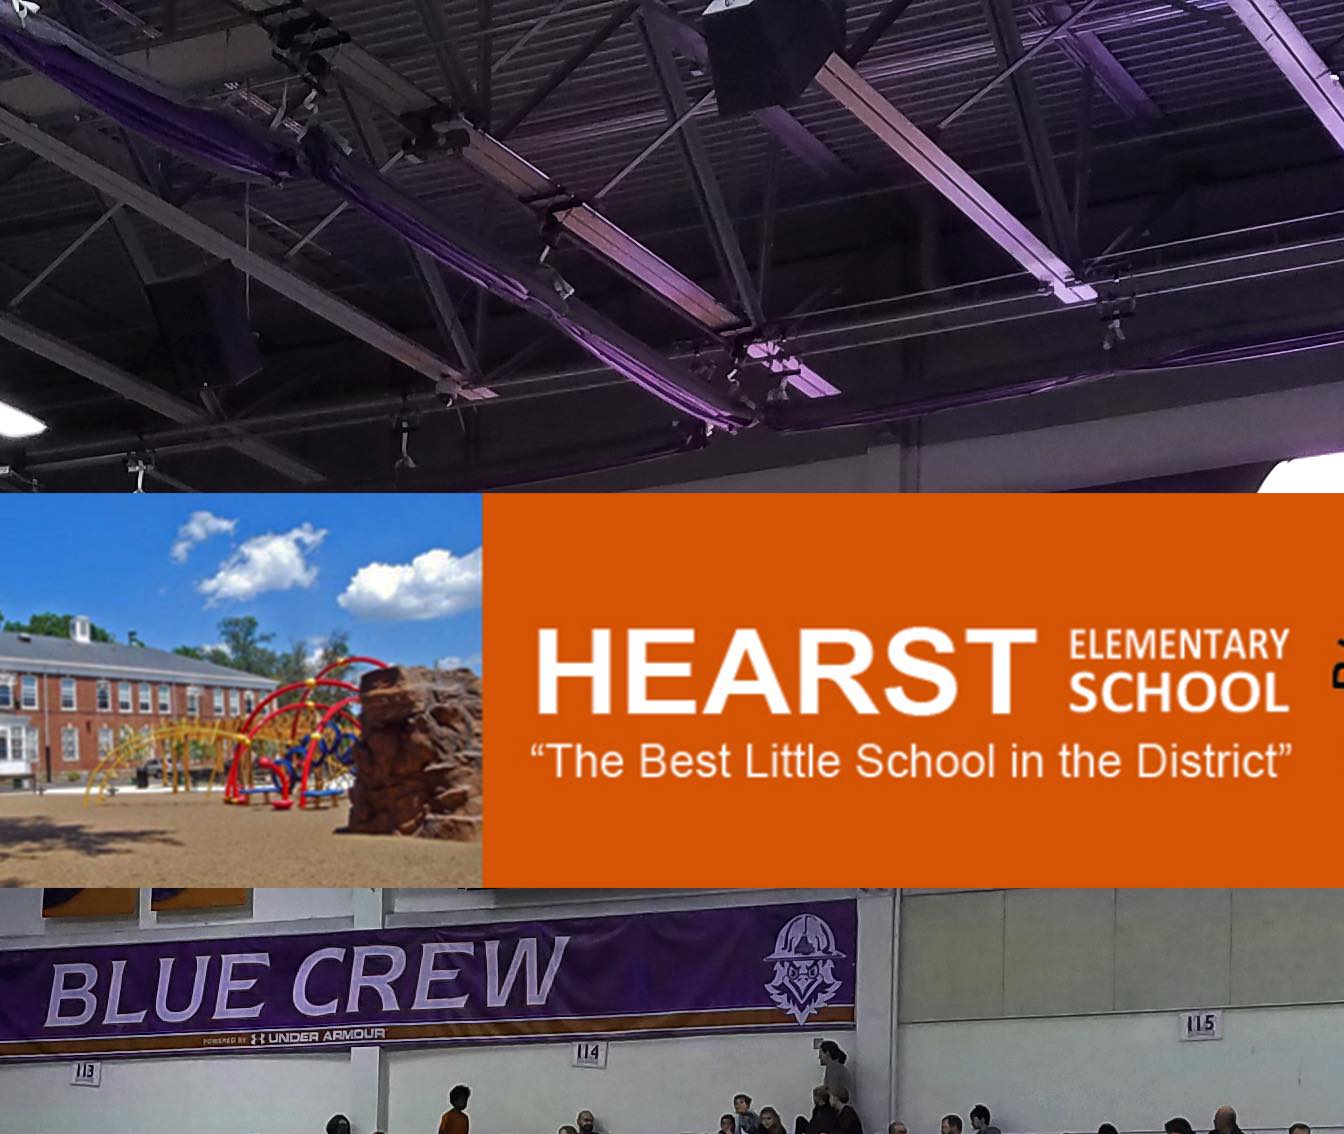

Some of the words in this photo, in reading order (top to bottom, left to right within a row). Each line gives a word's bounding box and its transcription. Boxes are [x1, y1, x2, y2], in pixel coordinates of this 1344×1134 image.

[43, 952, 271, 1028] BLUE
[292, 936, 572, 1017] CREW
[1187, 1014, 1215, 1032] 115
[268, 1031, 319, 1044] UNDER
[322, 1028, 386, 1042] ARMOUR
[577, 1044, 599, 1060] 114
[76, 1063, 95, 1078] 113
